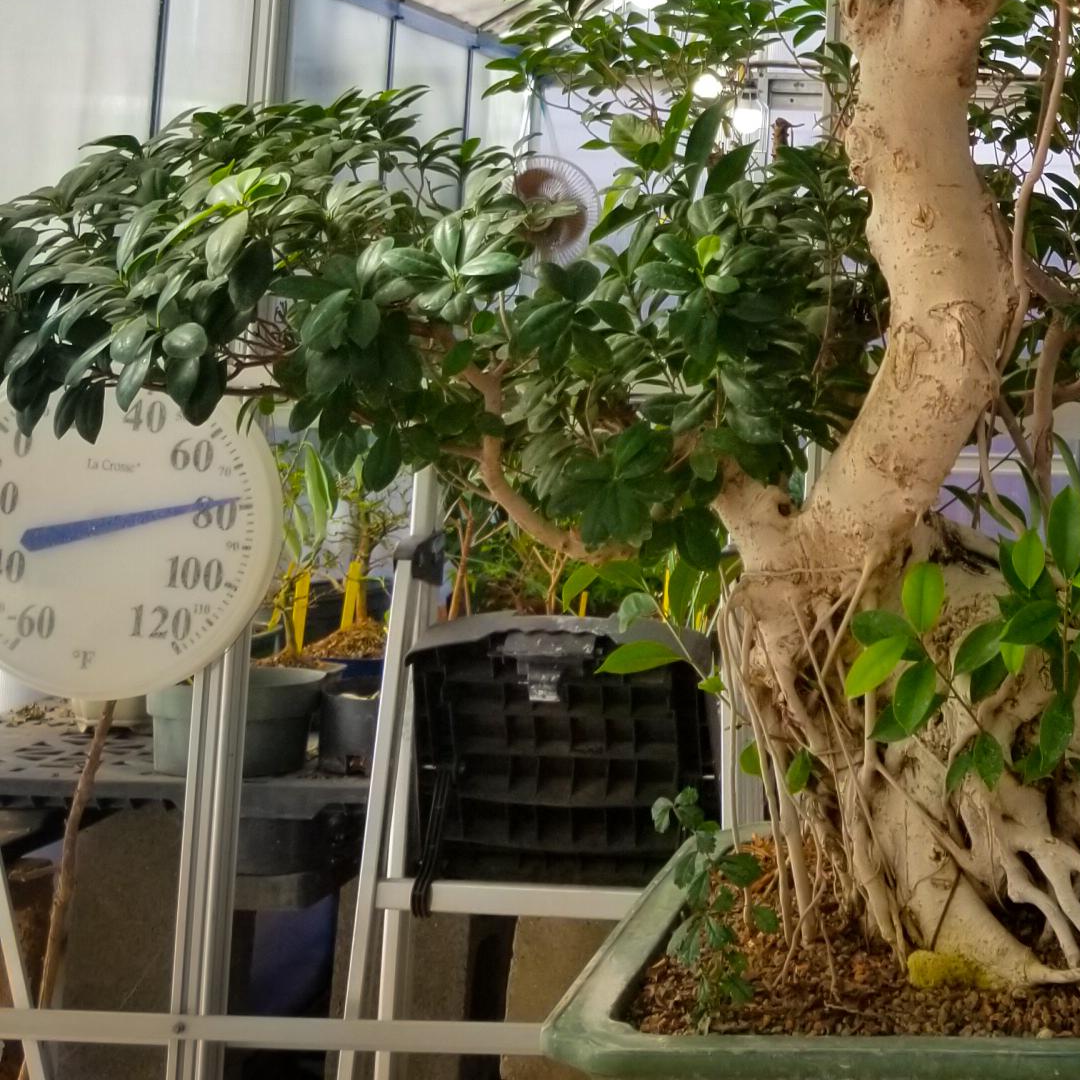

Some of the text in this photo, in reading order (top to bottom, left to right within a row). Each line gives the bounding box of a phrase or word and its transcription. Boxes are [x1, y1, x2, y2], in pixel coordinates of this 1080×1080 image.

[122, 398, 167, 433] 40
[169, 437, 214, 472] 60
[192, 496, 238, 532] 80
[0, 549, 25, 583] 0
[166, 555, 223, 591] 100
[7, 604, 56, 639] -60
[129, 603, 192, 641] 120
